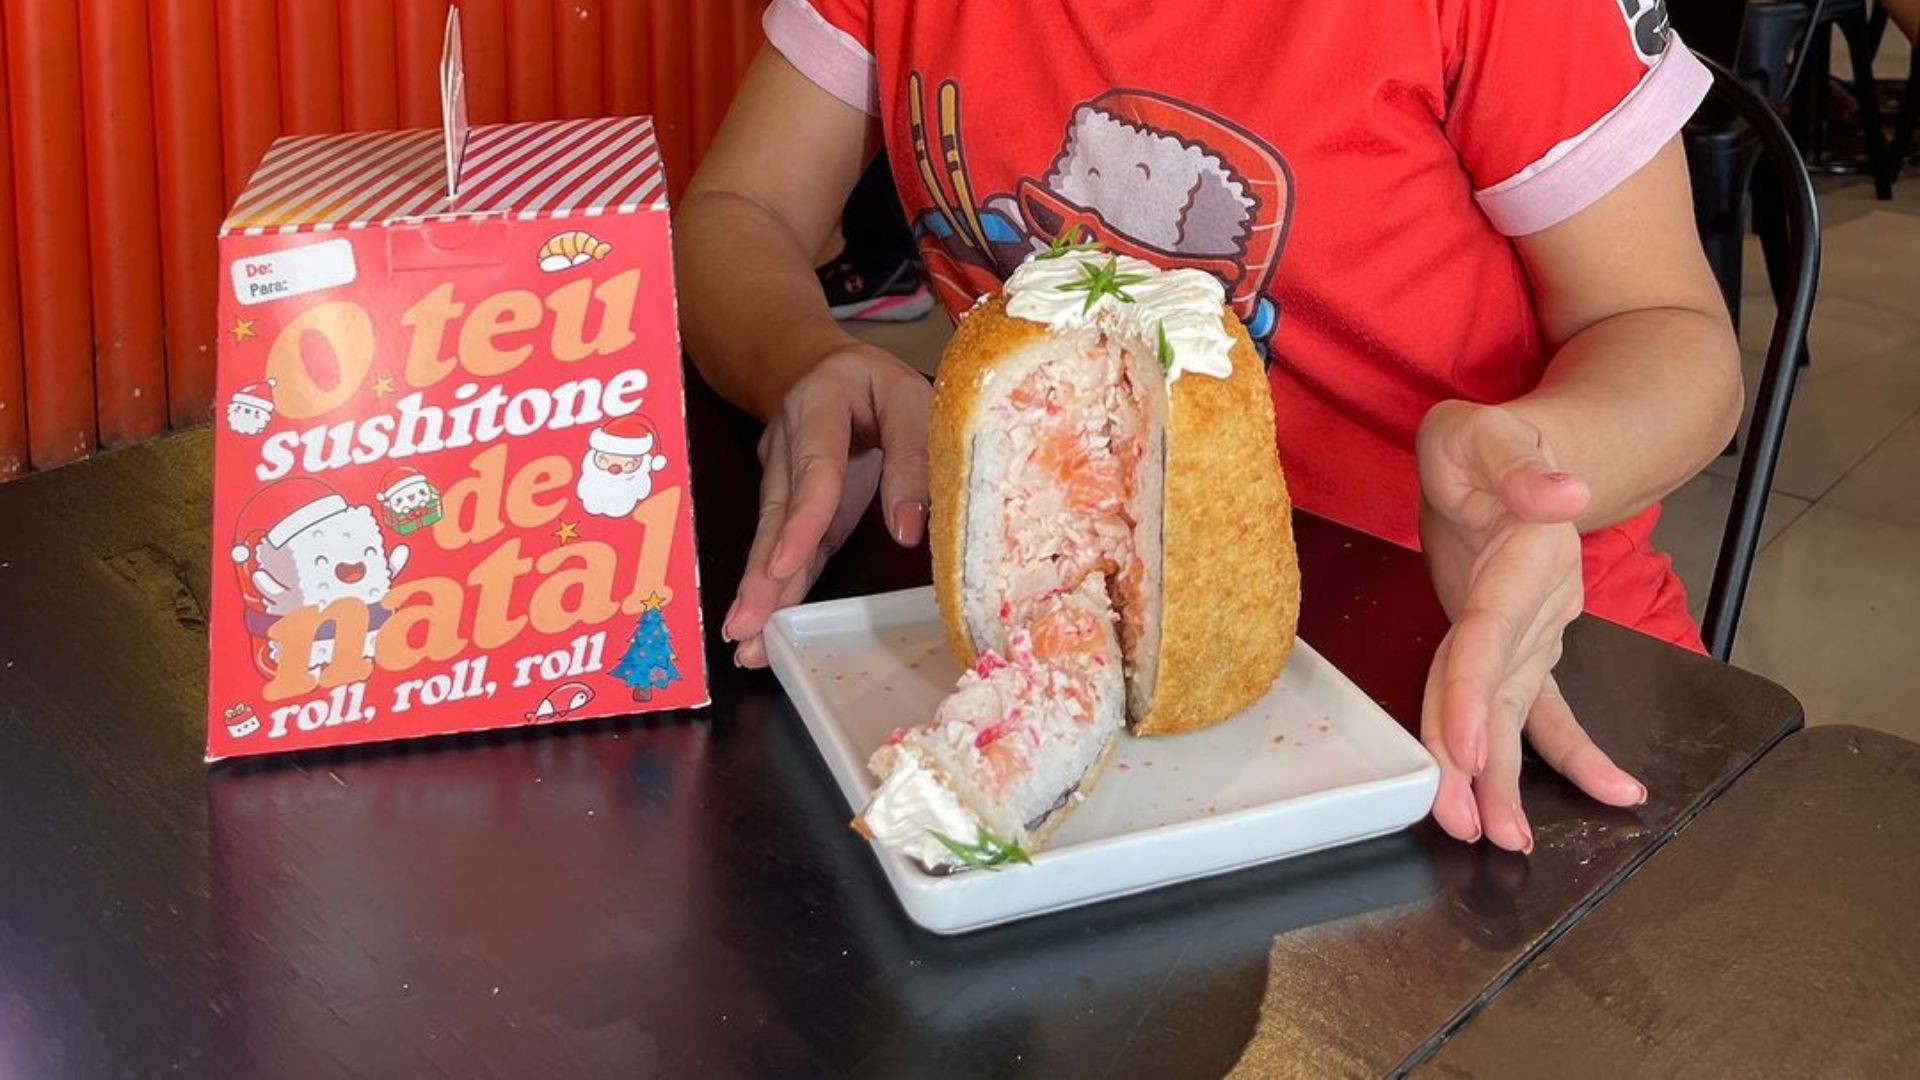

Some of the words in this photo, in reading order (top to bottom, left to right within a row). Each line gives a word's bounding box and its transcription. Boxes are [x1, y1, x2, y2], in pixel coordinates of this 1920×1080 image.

[245, 262, 273, 278] De:
[249, 279, 288, 297] Para:
[265, 301, 374, 419] O
[401, 268, 641, 388] teu
[256, 369, 648, 481] sushitone
[432, 445, 573, 549] de
[263, 486, 682, 700] natal
[268, 682, 376, 739] roll,
[394, 655, 498, 708] roll,
[513, 632, 606, 686] roll
